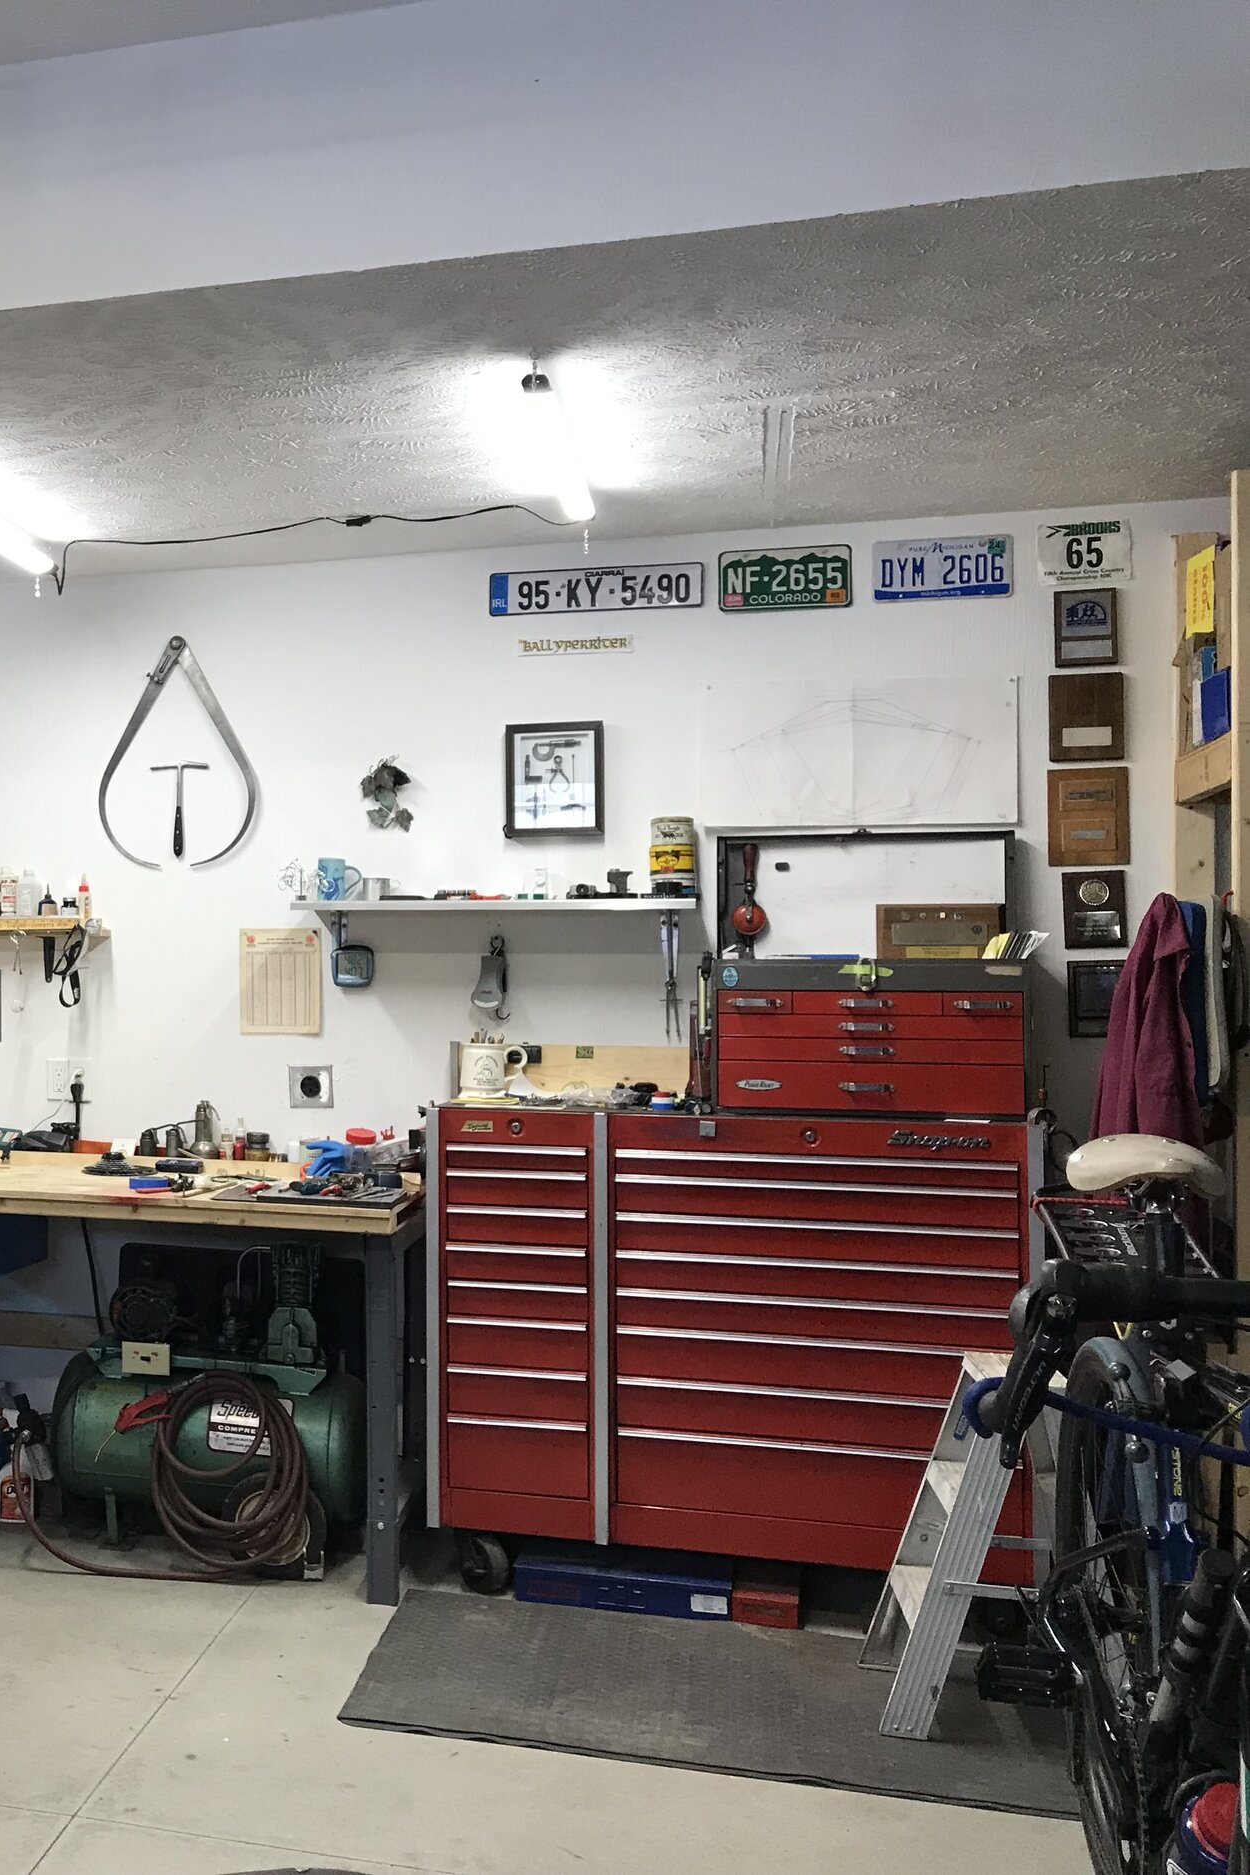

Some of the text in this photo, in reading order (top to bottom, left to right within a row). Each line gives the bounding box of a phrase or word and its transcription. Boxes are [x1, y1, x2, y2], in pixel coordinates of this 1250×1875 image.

[1066, 536, 1103, 569] 65
[881, 553, 1004, 588] DYM 2606
[492, 598, 508, 608] IRL
[749, 592, 821, 605] COLORADO
[887, 1129, 992, 1151] Snap-on
